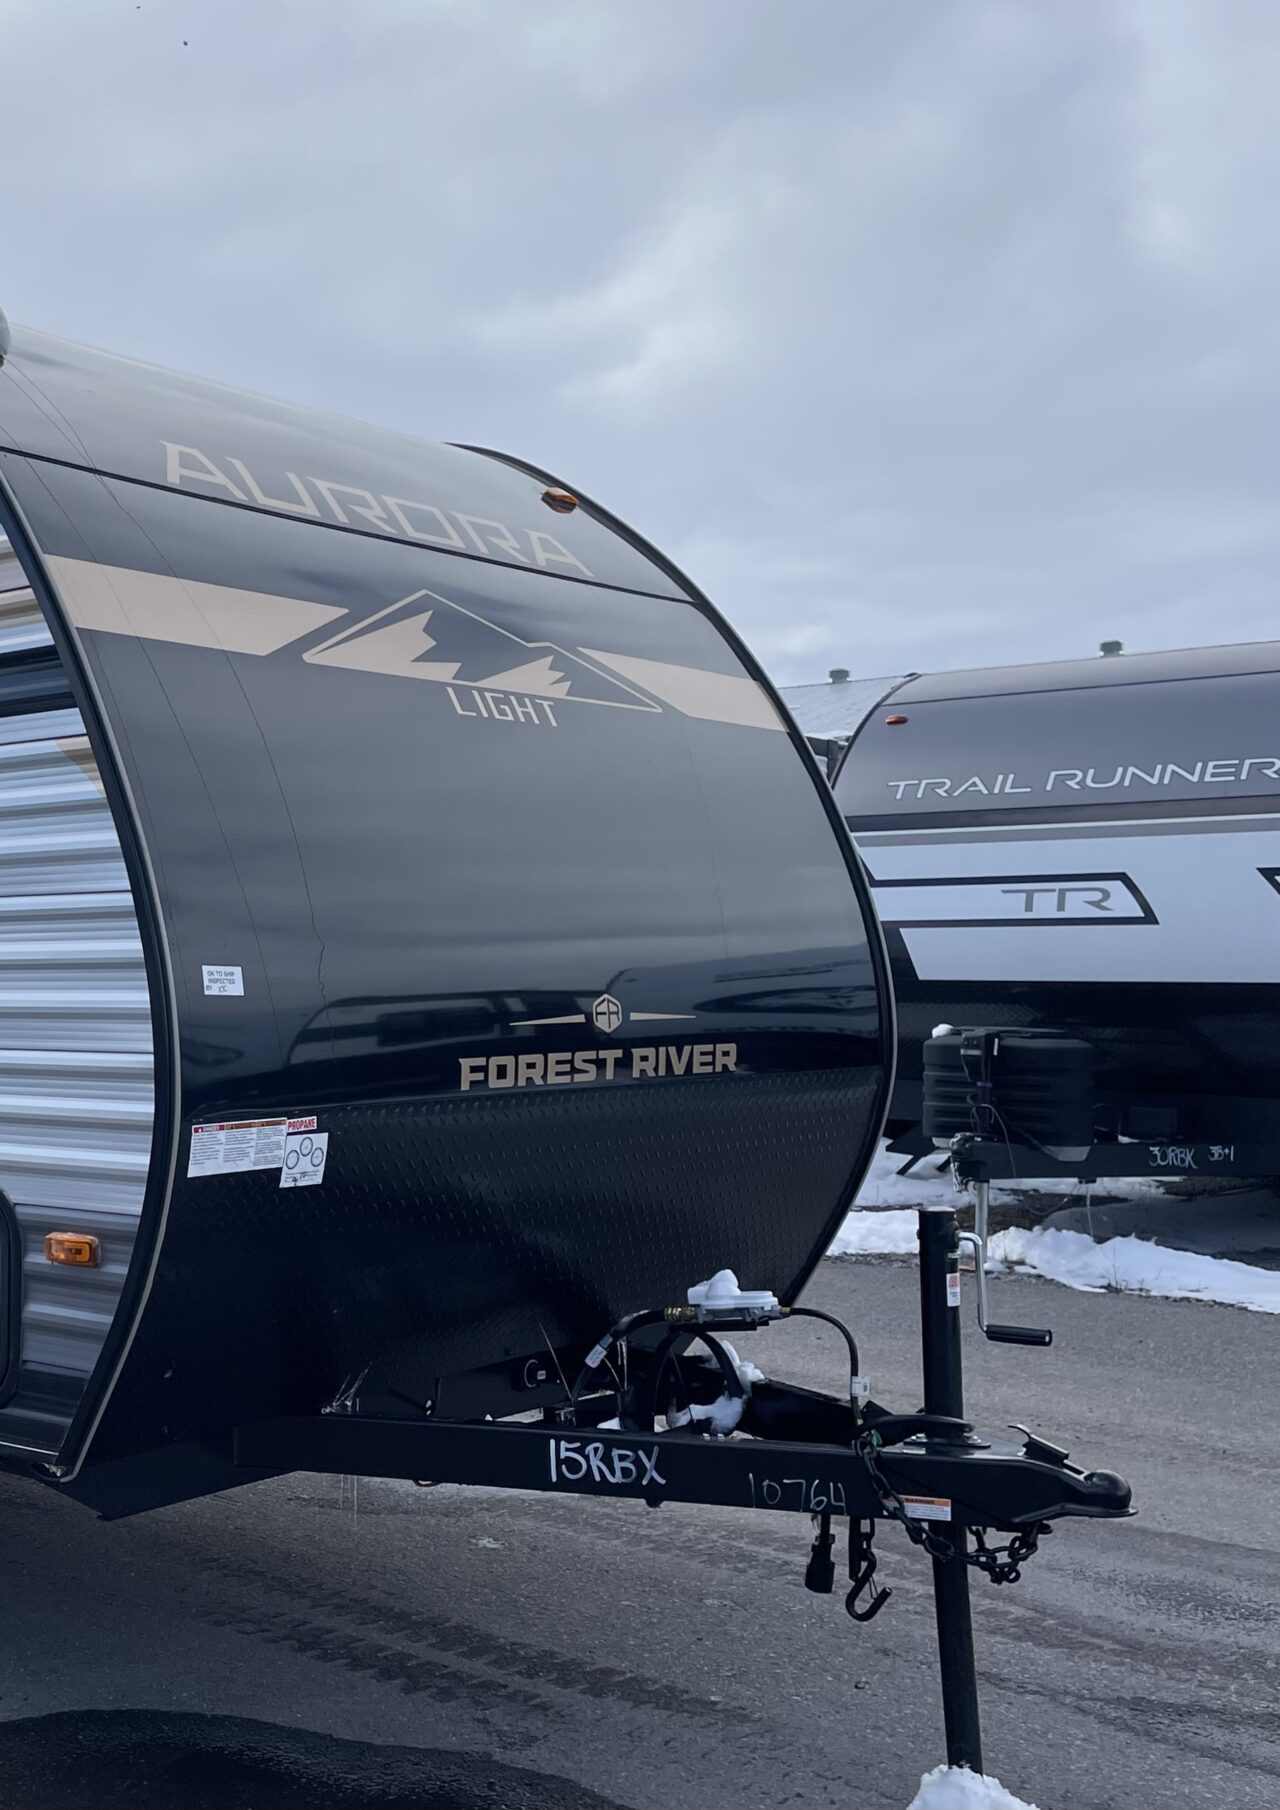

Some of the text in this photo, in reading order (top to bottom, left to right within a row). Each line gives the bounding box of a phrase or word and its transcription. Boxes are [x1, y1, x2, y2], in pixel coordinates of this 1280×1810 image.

[159, 440, 594, 577] AURORA
[446, 686, 558, 727] LIGHT
[887, 757, 1280, 800] TRAIL RUNNER
[1000, 886, 1115, 913] TR
[458, 1043, 738, 1091] FOREST RIVER
[287, 1118, 316, 1131] PROPANE
[549, 1438, 667, 1486] 15RBX
[748, 1472, 847, 1516] 10764
